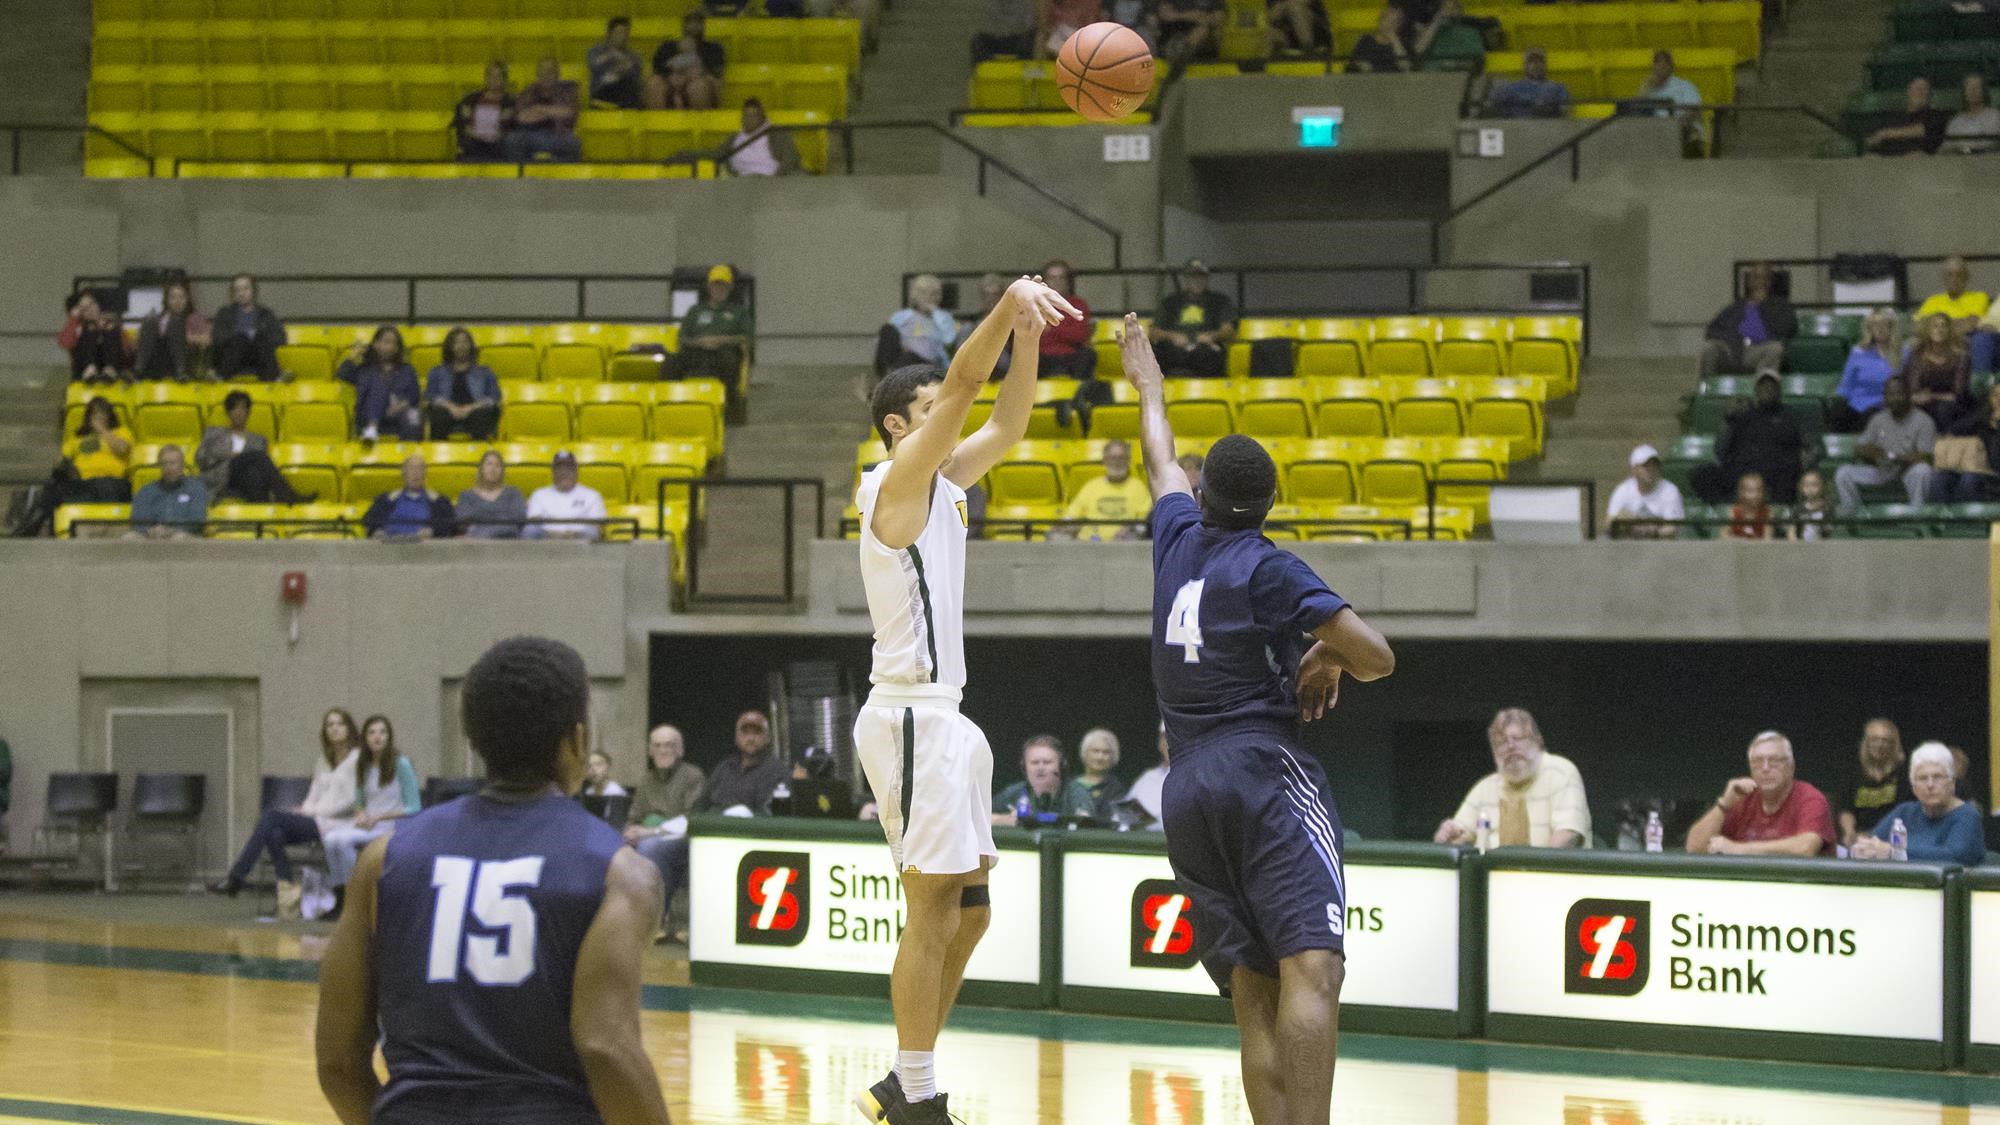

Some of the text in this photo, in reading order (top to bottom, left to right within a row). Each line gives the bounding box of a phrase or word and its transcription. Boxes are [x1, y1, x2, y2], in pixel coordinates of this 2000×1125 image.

[1165, 578, 1205, 663] 4
[427, 855, 545, 986] 15
[1326, 902, 1343, 936] S
[1670, 912, 1857, 956] Simmons
[1670, 956, 1767, 995] Bank
